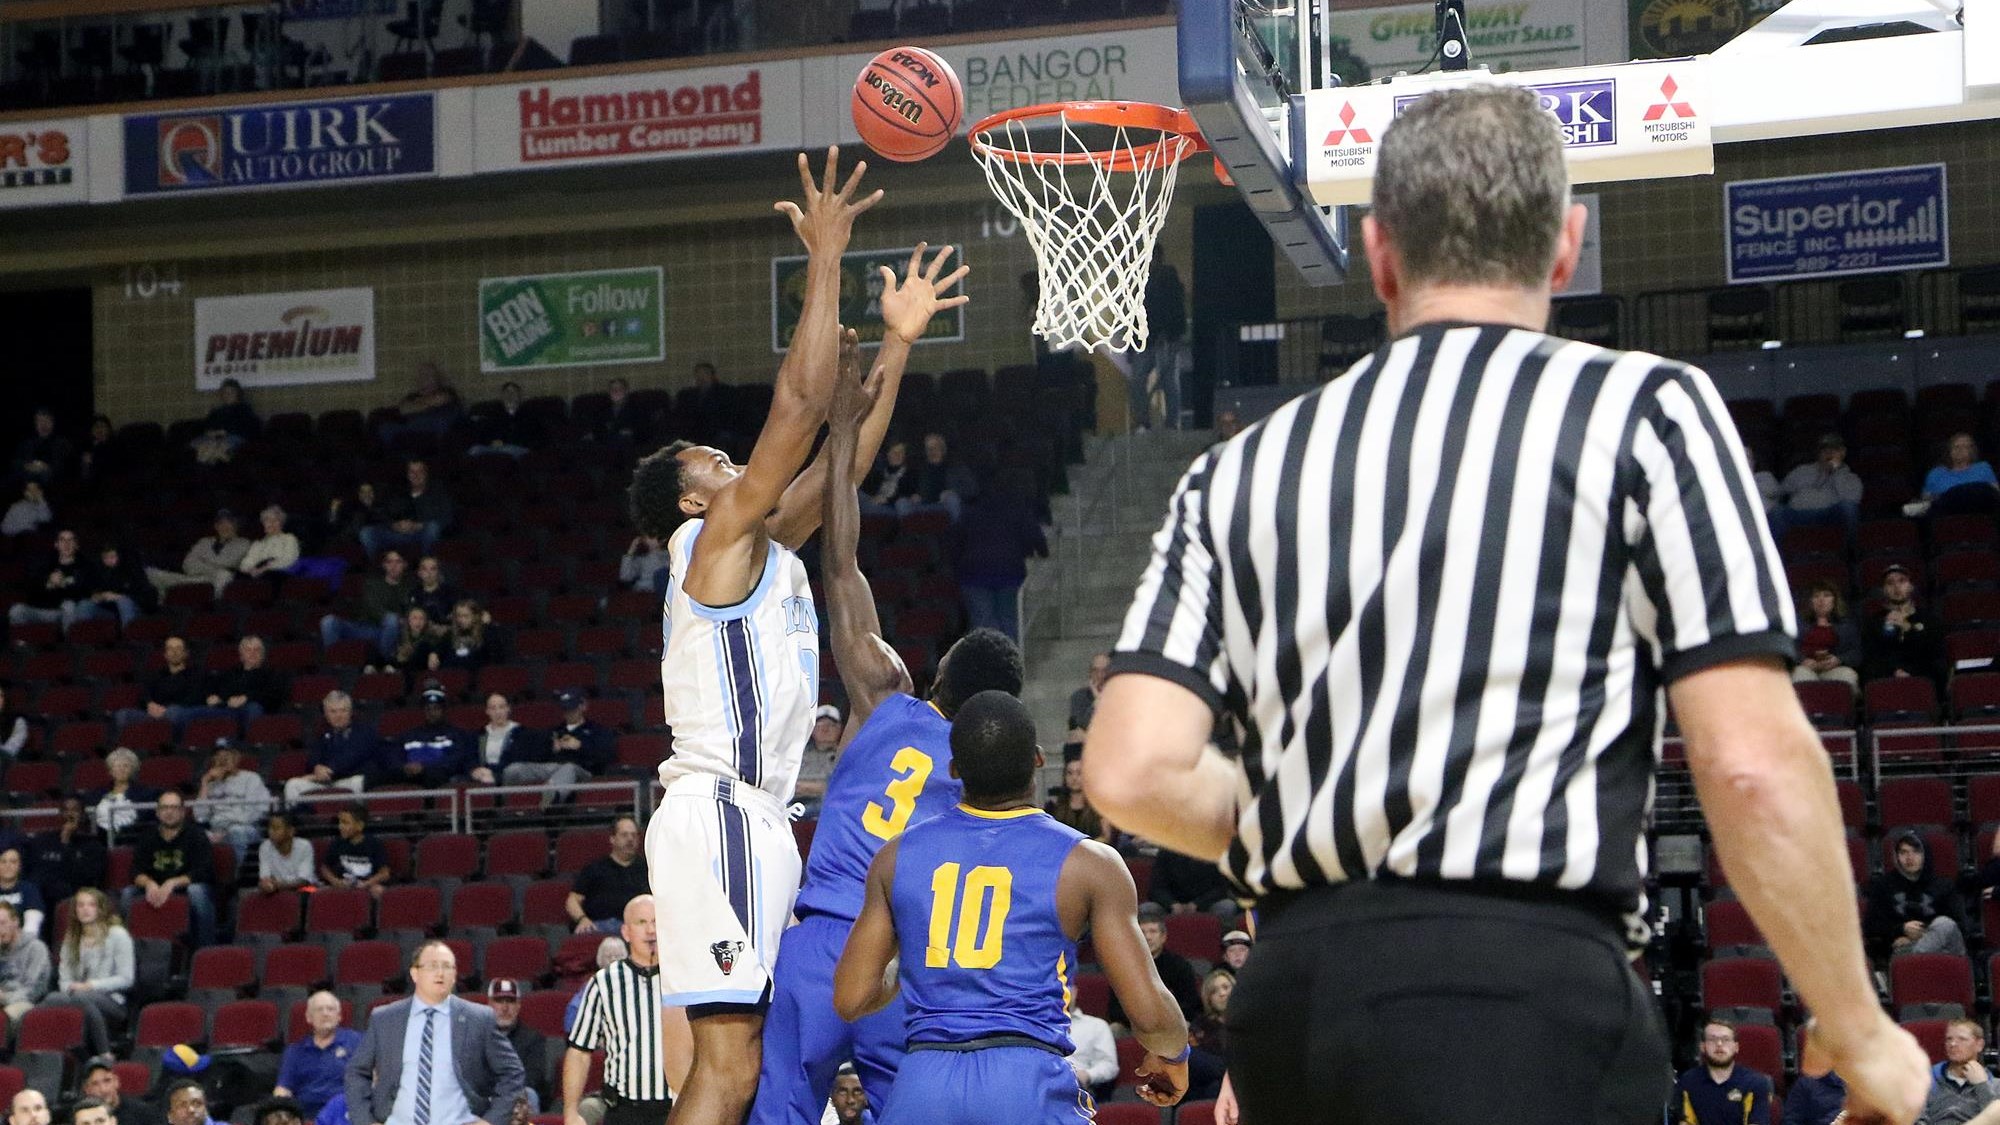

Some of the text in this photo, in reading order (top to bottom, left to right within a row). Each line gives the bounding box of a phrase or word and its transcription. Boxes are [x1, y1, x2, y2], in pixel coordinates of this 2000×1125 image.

[891, 52, 940, 88] NCAA
[966, 45, 1126, 87] BANGOR
[519, 70, 762, 128] Hammond
[864, 70, 923, 125] Wilson
[162, 102, 400, 184] QUIRK
[524, 120, 755, 156] Lumber Company
[1643, 121, 1695, 133] MITSUBISHI
[1651, 132, 1689, 143] MOTORS
[227, 147, 401, 181] AUTO GROUP
[1323, 147, 1372, 158] MITSUBISHI
[1330, 157, 1365, 168] MOTORS
[1734, 194, 1903, 238] Superior
[1735, 236, 1842, 259] FENCE INC.
[567, 283, 650, 315] Follow
[205, 319, 363, 363] PREMIUM
[862, 746, 933, 841] 3
[925, 861, 1013, 970] 10
